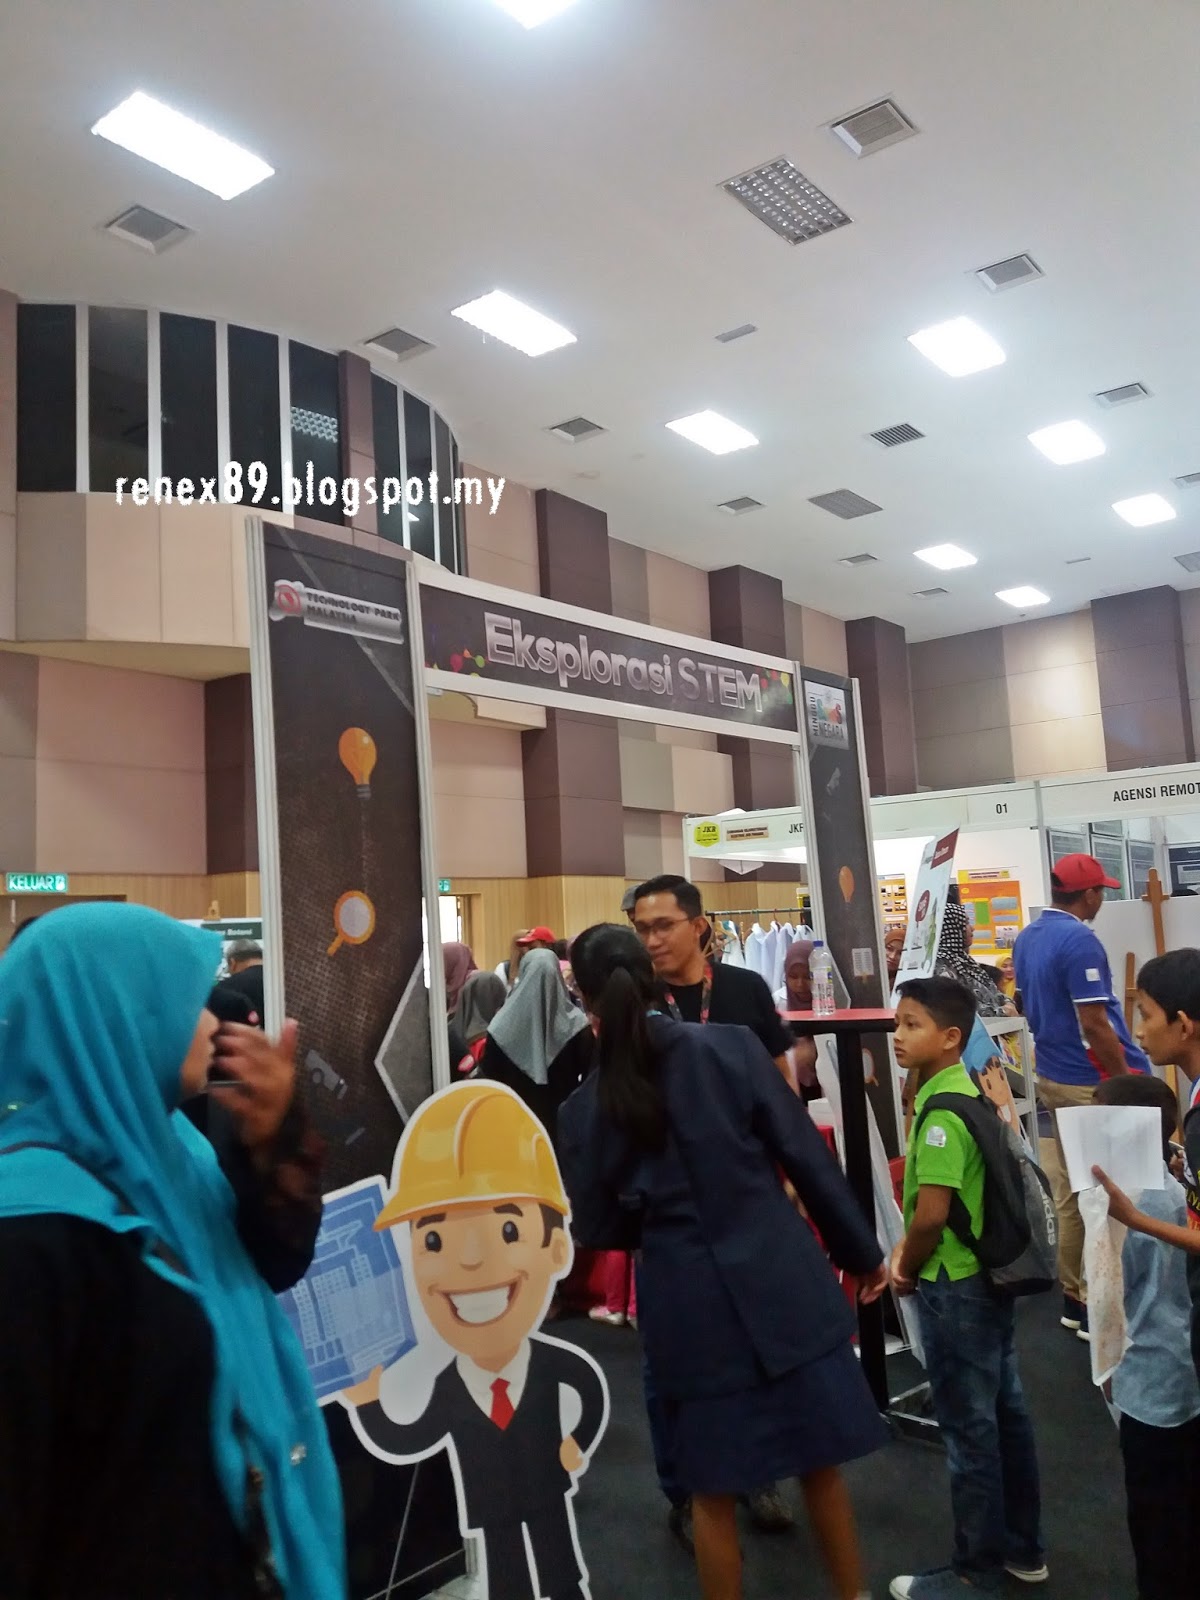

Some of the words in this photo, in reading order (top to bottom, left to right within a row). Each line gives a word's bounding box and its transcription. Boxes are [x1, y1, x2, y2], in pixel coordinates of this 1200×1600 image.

[306, 592, 371, 615] TECHNOLOGY
[374, 607, 400, 621] PARK
[484, 611, 674, 696] Eksplorasi
[678, 657, 763, 713] STEM
[1113, 786, 1157, 803] AGENSI
[1160, 782, 1200, 798] REMOT
[995, 803, 1008, 815] 01
[9, 874, 55, 891] KELUAR
